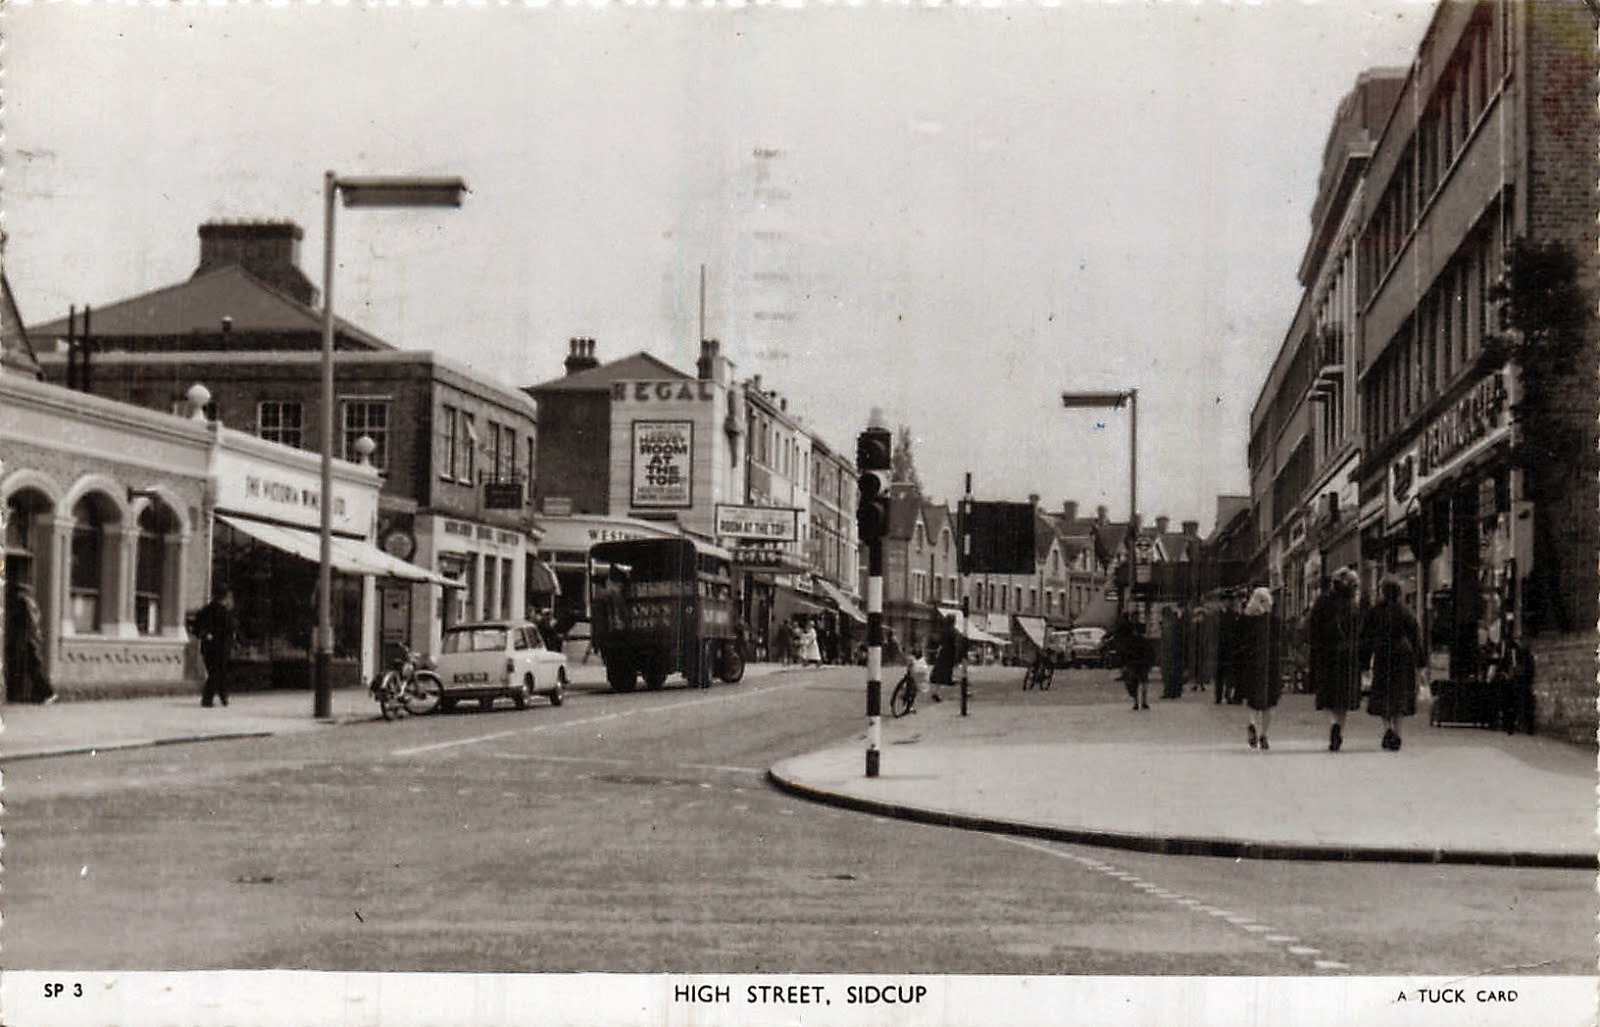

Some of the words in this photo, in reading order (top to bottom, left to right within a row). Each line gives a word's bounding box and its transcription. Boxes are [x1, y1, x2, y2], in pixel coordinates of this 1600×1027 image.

[611, 381, 714, 401] REGAL
[640, 444, 688, 455] ROOM
[650, 455, 673, 465] AT
[645, 465, 680, 475] THE
[645, 475, 681, 485] TOP
